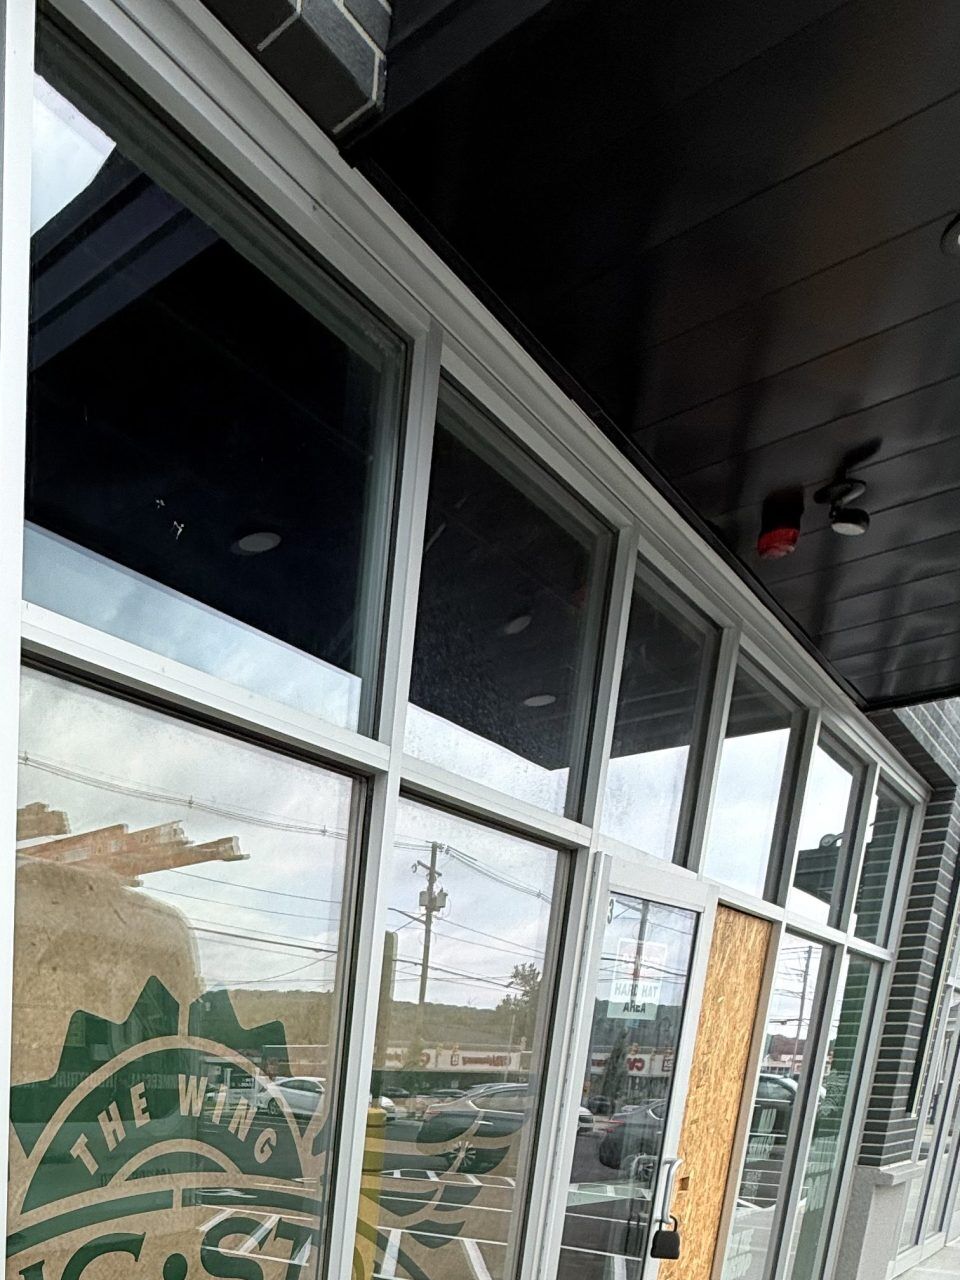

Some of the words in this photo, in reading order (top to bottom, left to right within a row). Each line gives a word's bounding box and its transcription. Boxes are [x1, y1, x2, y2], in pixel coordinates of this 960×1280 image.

[641, 983, 659, 999] HAT
[622, 1001, 646, 1014] AREA
[70, 1081, 152, 1176] THE
[178, 1073, 278, 1164] WING
